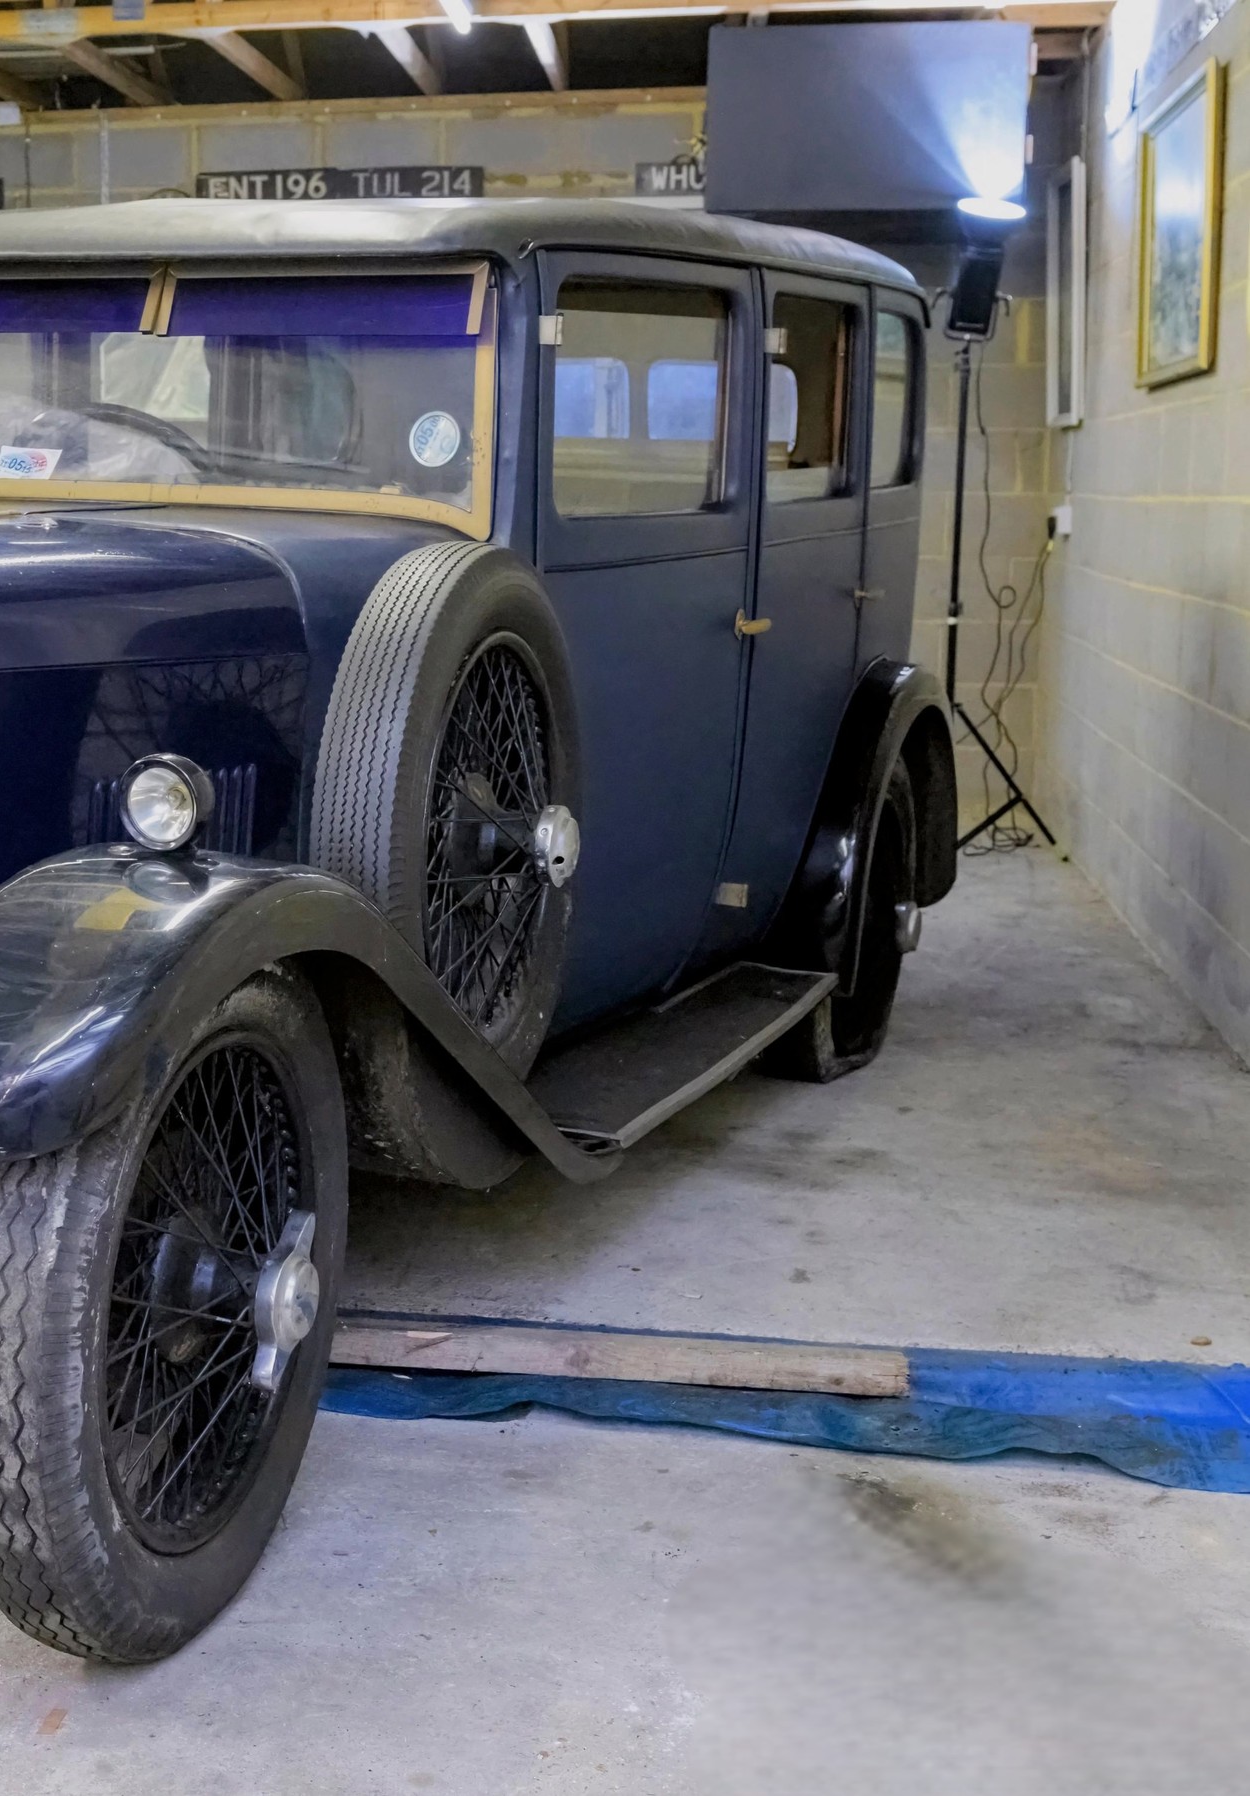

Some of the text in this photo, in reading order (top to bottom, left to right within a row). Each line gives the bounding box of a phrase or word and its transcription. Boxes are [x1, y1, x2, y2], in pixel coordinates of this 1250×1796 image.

[207, 171, 328, 200] ENT 196
[351, 169, 472, 198] TUL 214
[8, 457, 26, 472] 05
